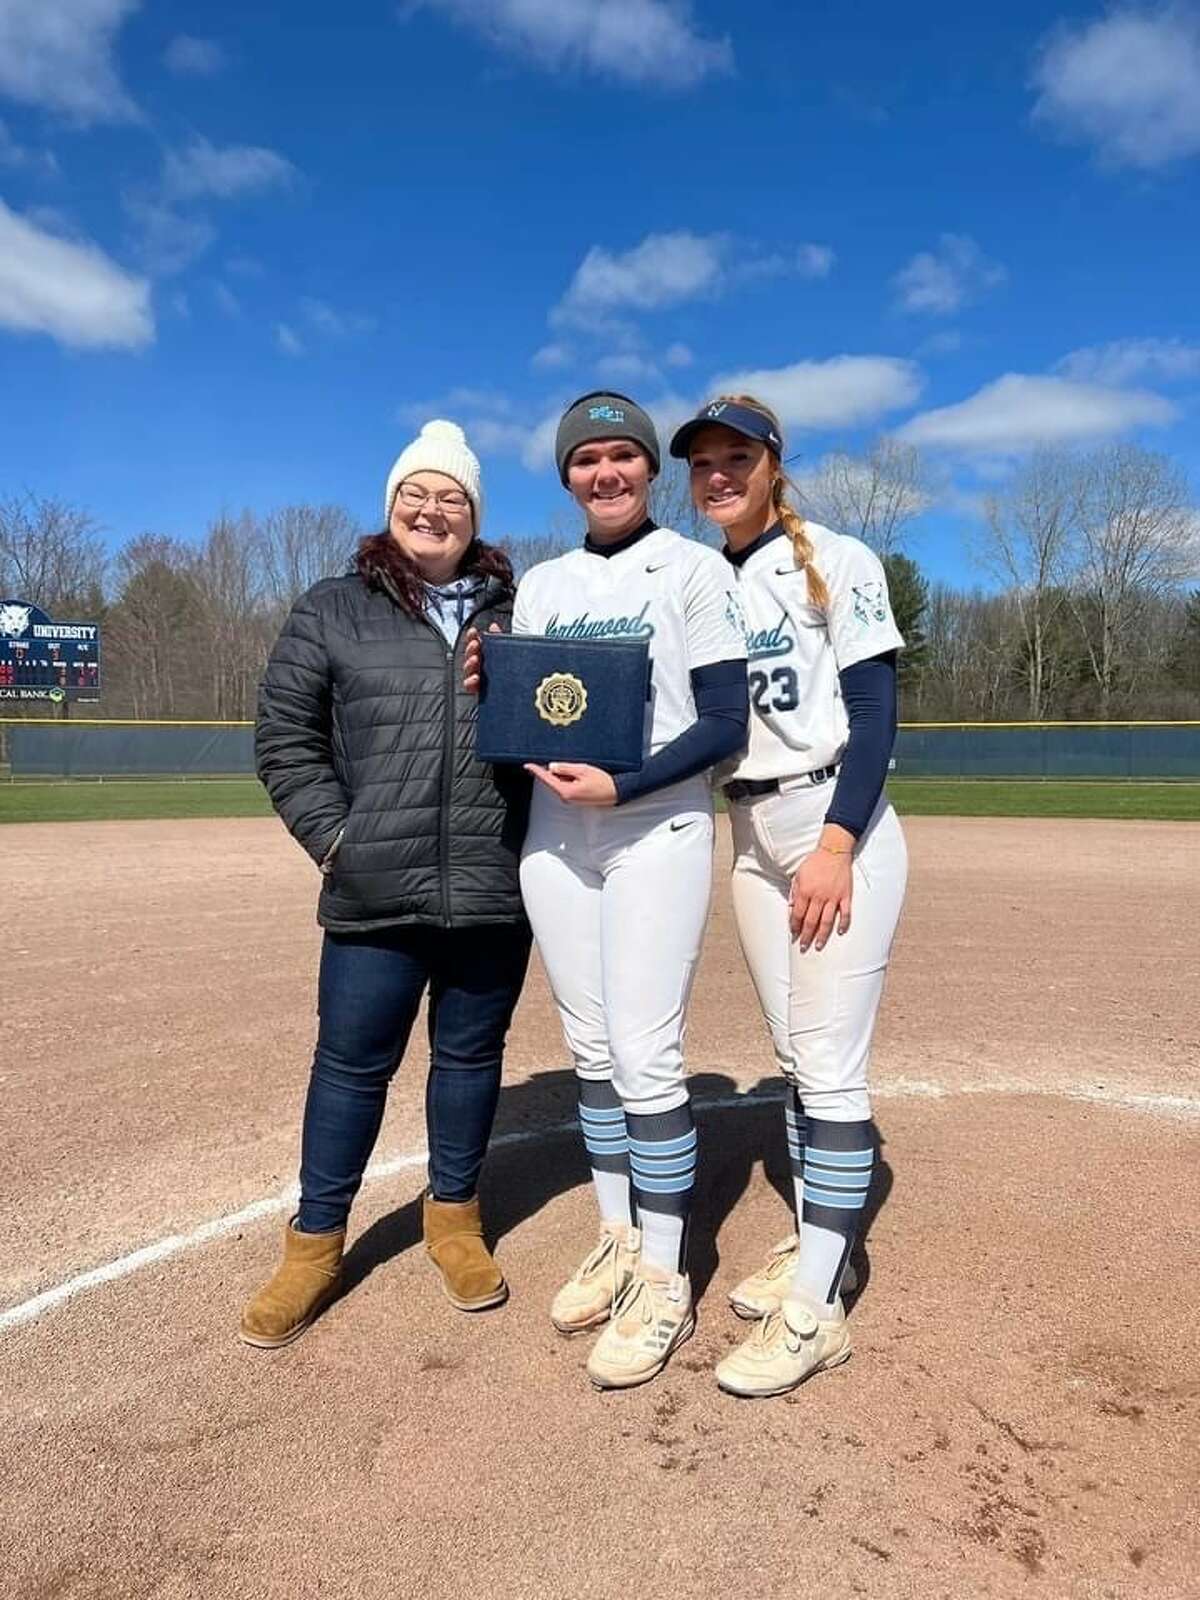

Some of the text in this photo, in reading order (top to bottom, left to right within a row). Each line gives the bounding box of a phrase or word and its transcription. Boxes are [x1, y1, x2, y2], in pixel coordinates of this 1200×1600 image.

[33, 624, 96, 639] UNIVERSITY
[21, 690, 49, 698] BANK
[750, 667, 799, 713] 23
